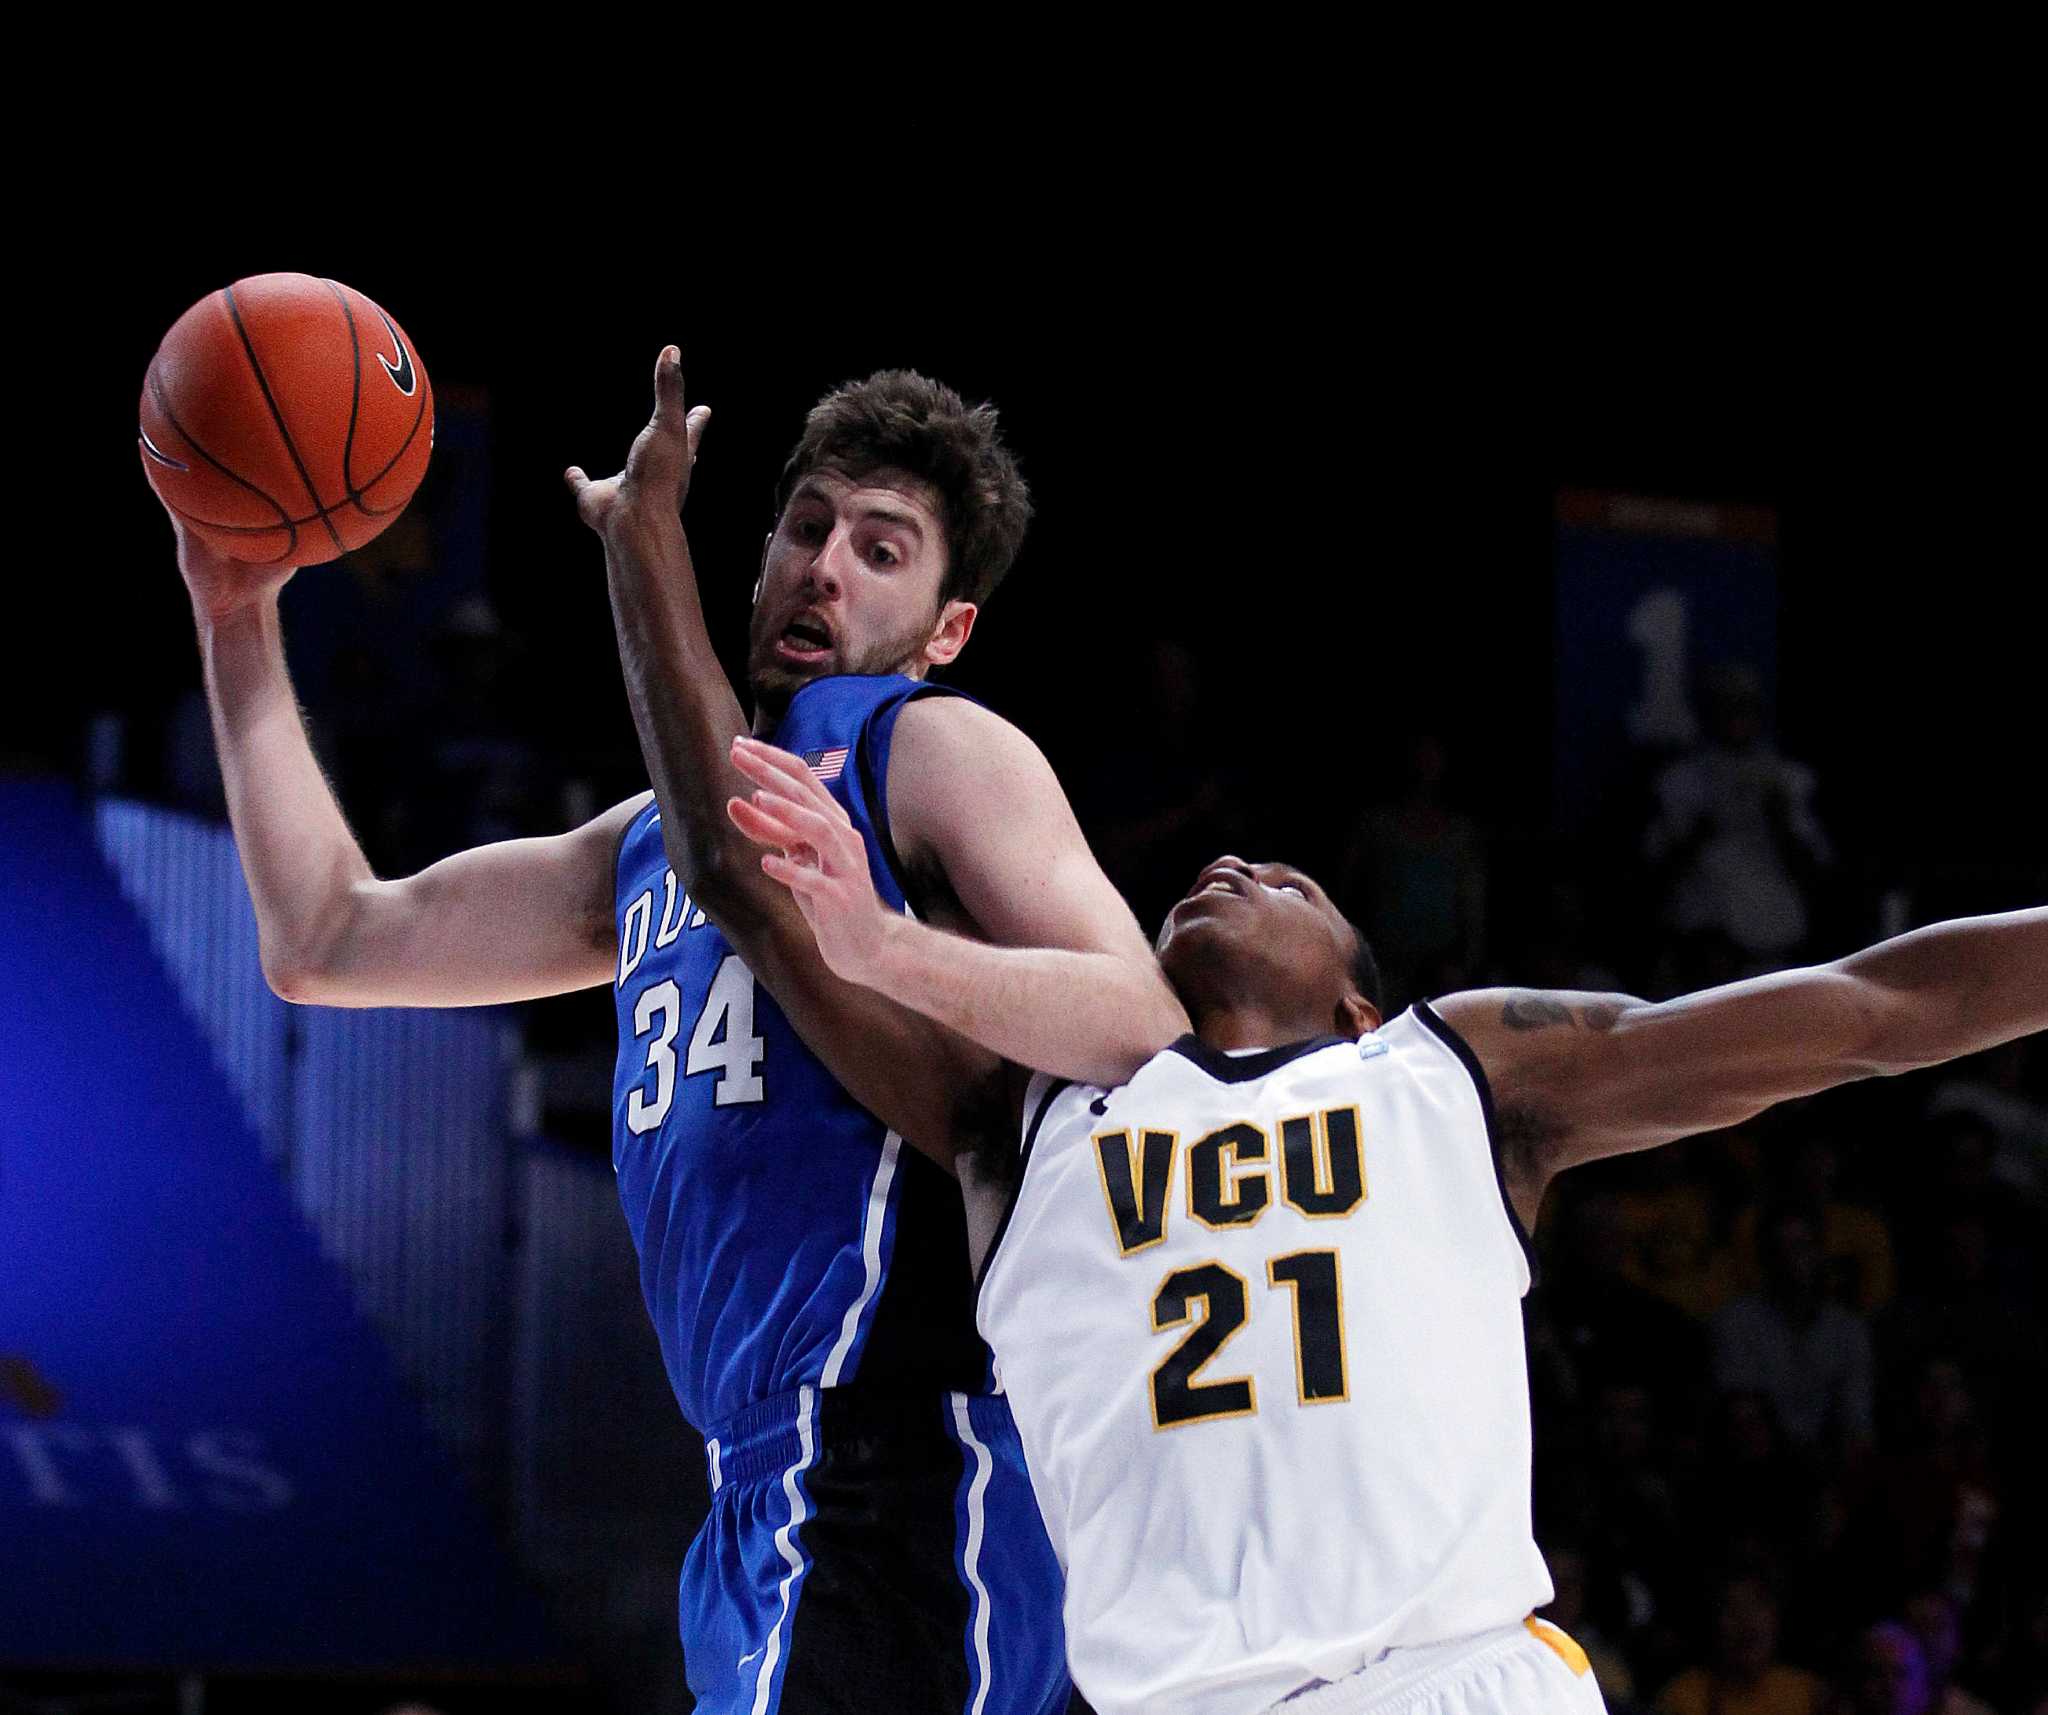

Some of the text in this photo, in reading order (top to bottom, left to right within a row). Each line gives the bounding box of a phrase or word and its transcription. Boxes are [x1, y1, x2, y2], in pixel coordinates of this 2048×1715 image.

[1625, 586, 1698, 747] 1
[618, 867, 712, 991] DU
[627, 952, 767, 1136] 34
[1091, 1104, 1367, 1258] VCU
[1148, 1248, 1349, 1432] 21
